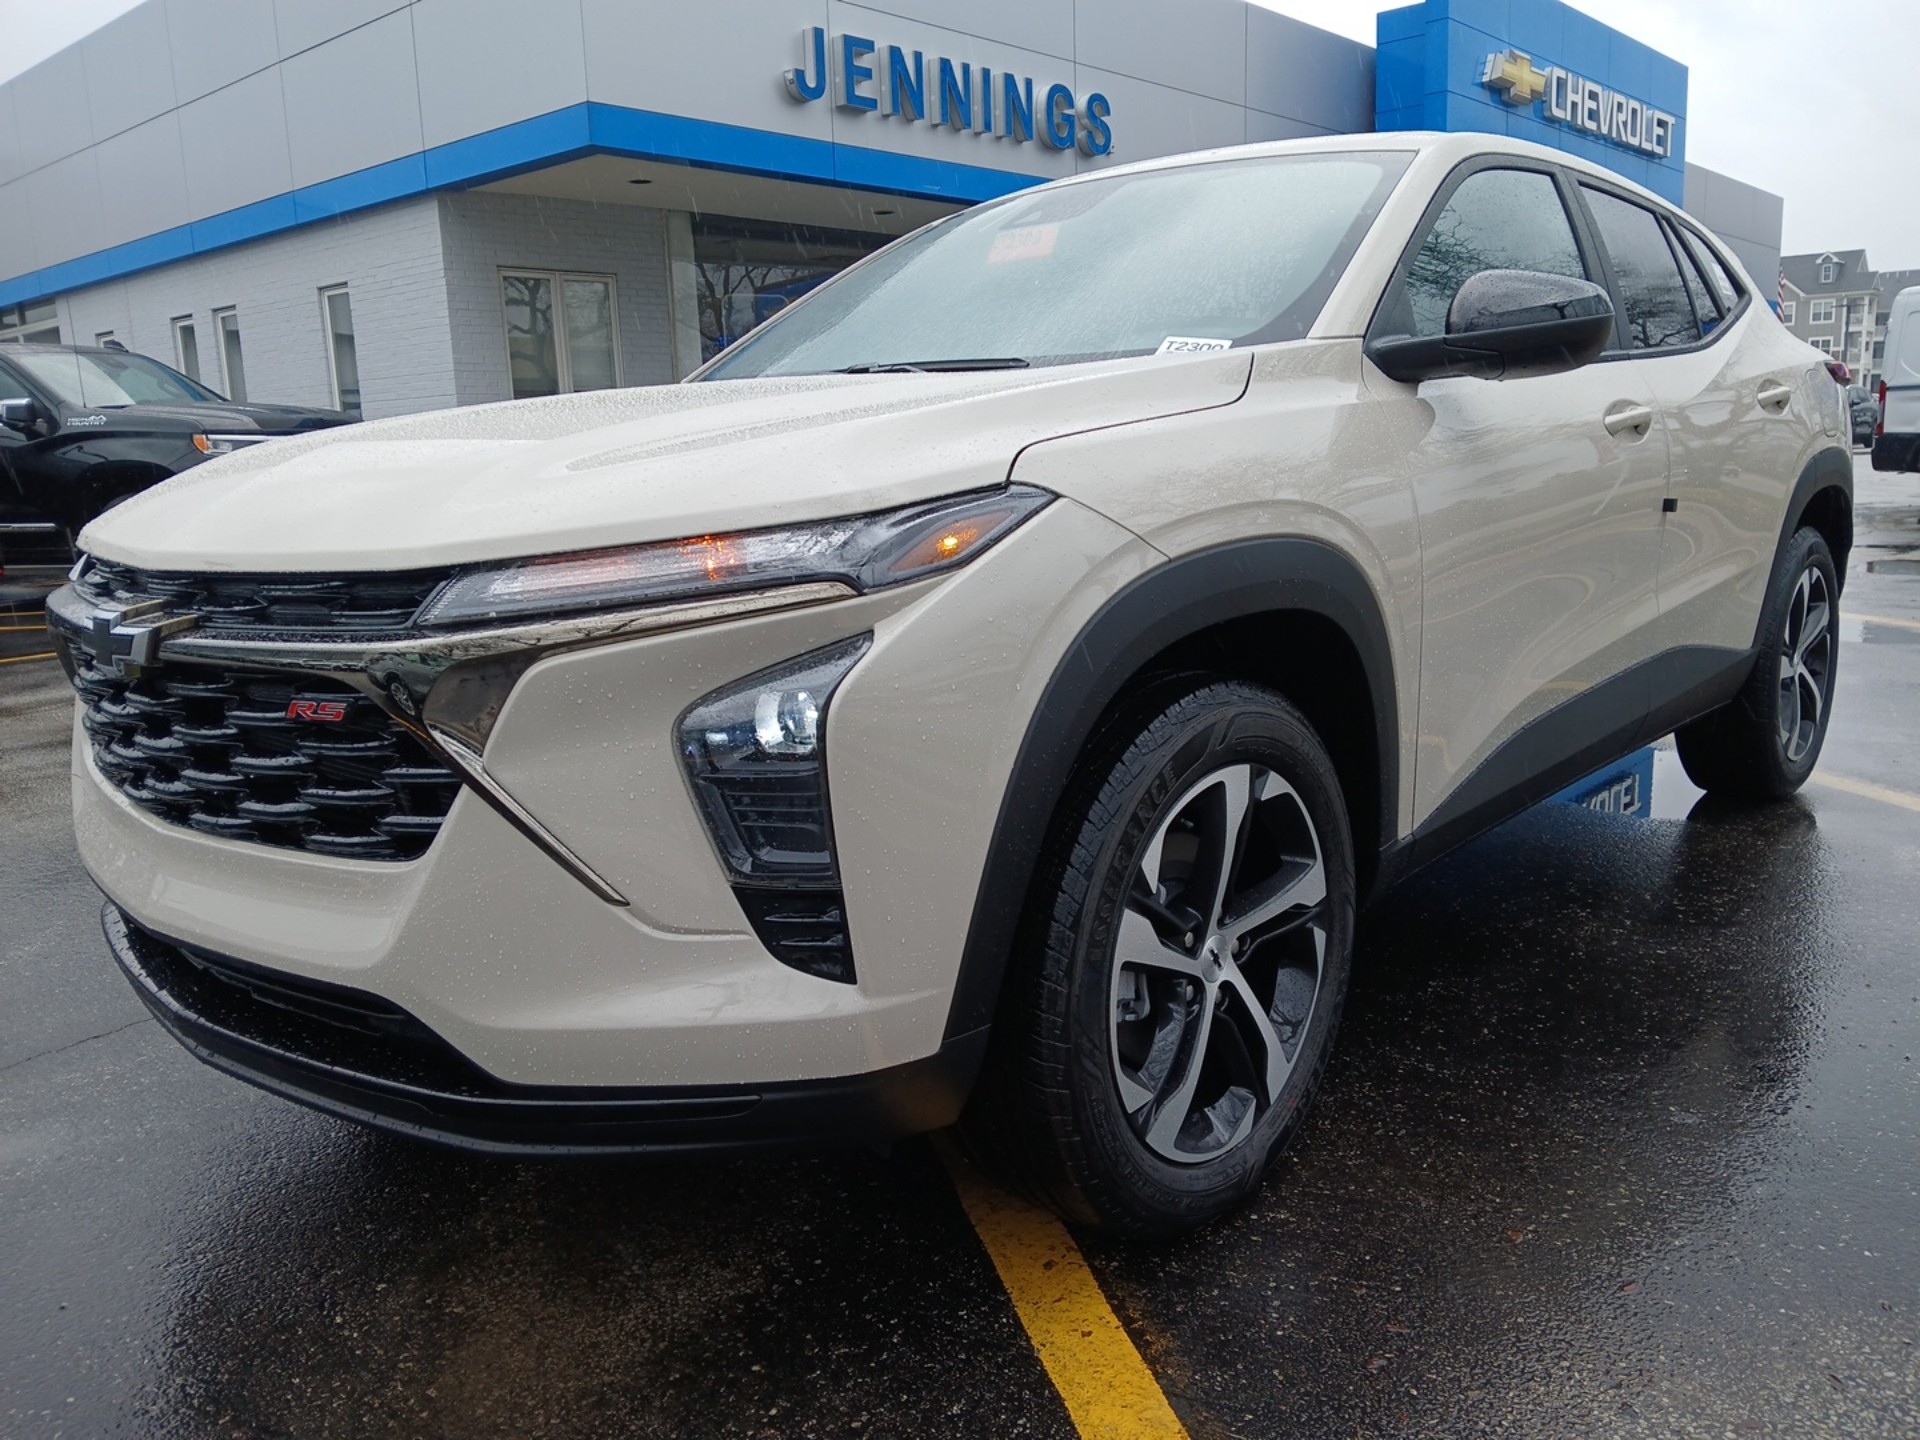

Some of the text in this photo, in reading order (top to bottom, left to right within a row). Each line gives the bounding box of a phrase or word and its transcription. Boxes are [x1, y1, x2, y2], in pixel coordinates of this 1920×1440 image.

[783, 26, 1112, 156] JENNINGS
[1544, 66, 1676, 158] CHEVROLET
[286, 700, 347, 722] RS
